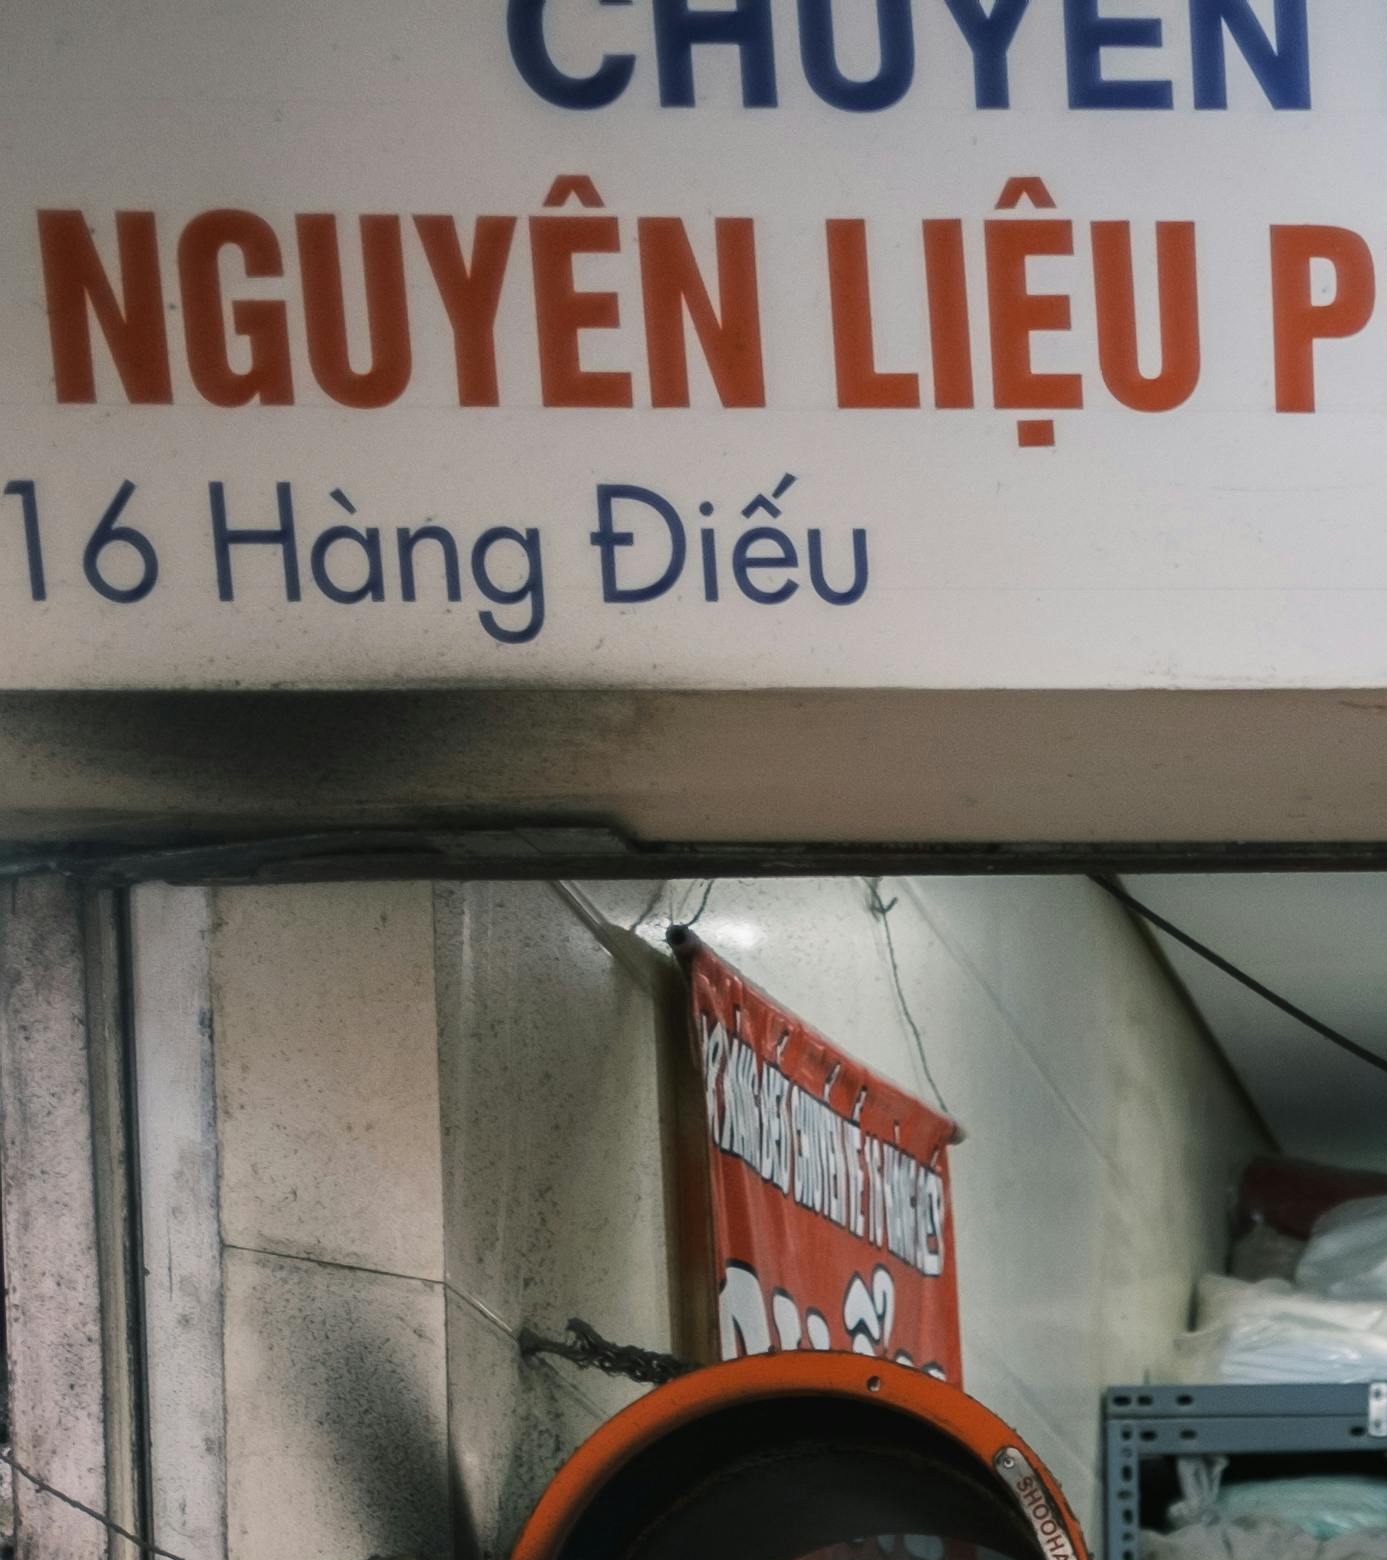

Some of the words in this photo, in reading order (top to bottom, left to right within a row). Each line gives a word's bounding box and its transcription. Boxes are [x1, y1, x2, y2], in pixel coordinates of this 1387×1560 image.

[37, 174, 767, 410] NGUYÊN
[825, 177, 1202, 448] LIỆU
[208, 480, 545, 644] Hàng
[590, 472, 870, 606] Điếu
